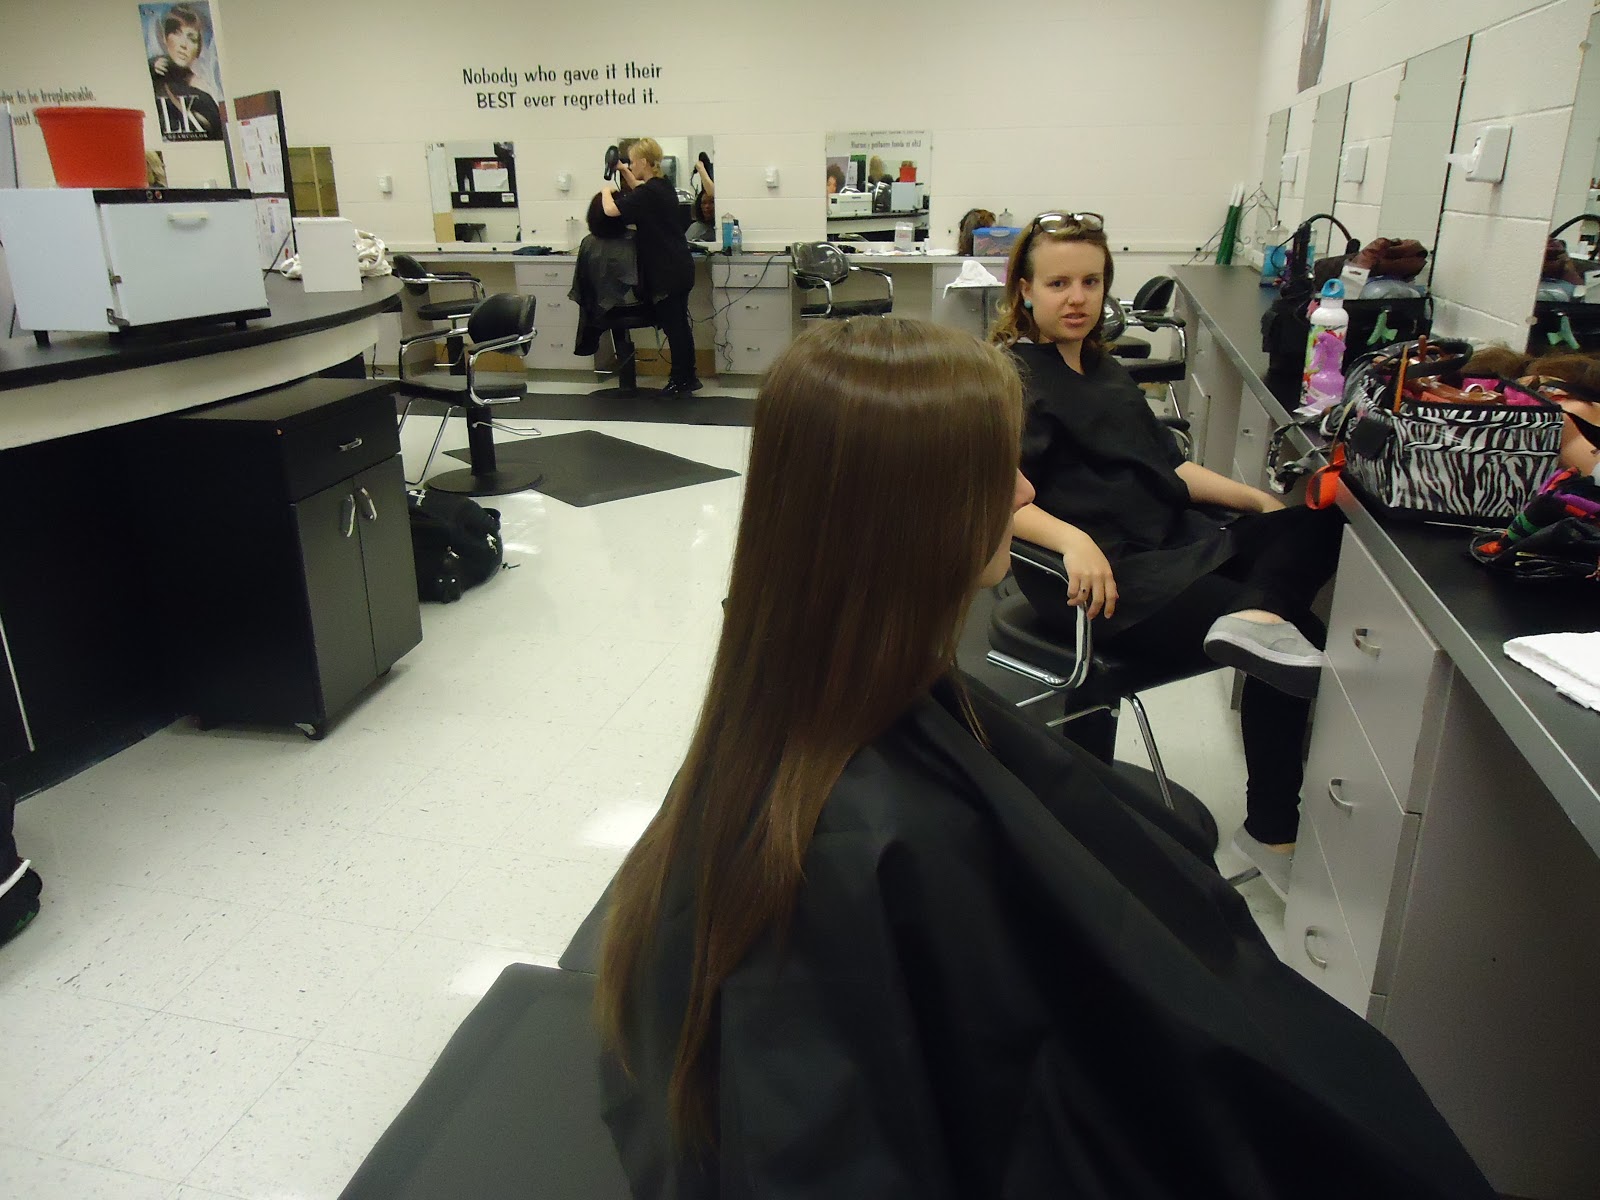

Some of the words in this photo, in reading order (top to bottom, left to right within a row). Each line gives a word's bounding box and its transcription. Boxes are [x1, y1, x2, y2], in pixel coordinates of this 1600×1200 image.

[463, 67, 518, 87] Nobody
[524, 65, 557, 82] who
[563, 67, 599, 86] gave
[605, 63, 617, 80] it
[624, 61, 663, 79] their
[17, 90, 27, 104] to
[476, 91, 516, 109] BEST
[524, 95, 557, 107] ever
[563, 87, 636, 110] regretted
[642, 87, 659, 104] it.
[157, 95, 207, 133] LK
